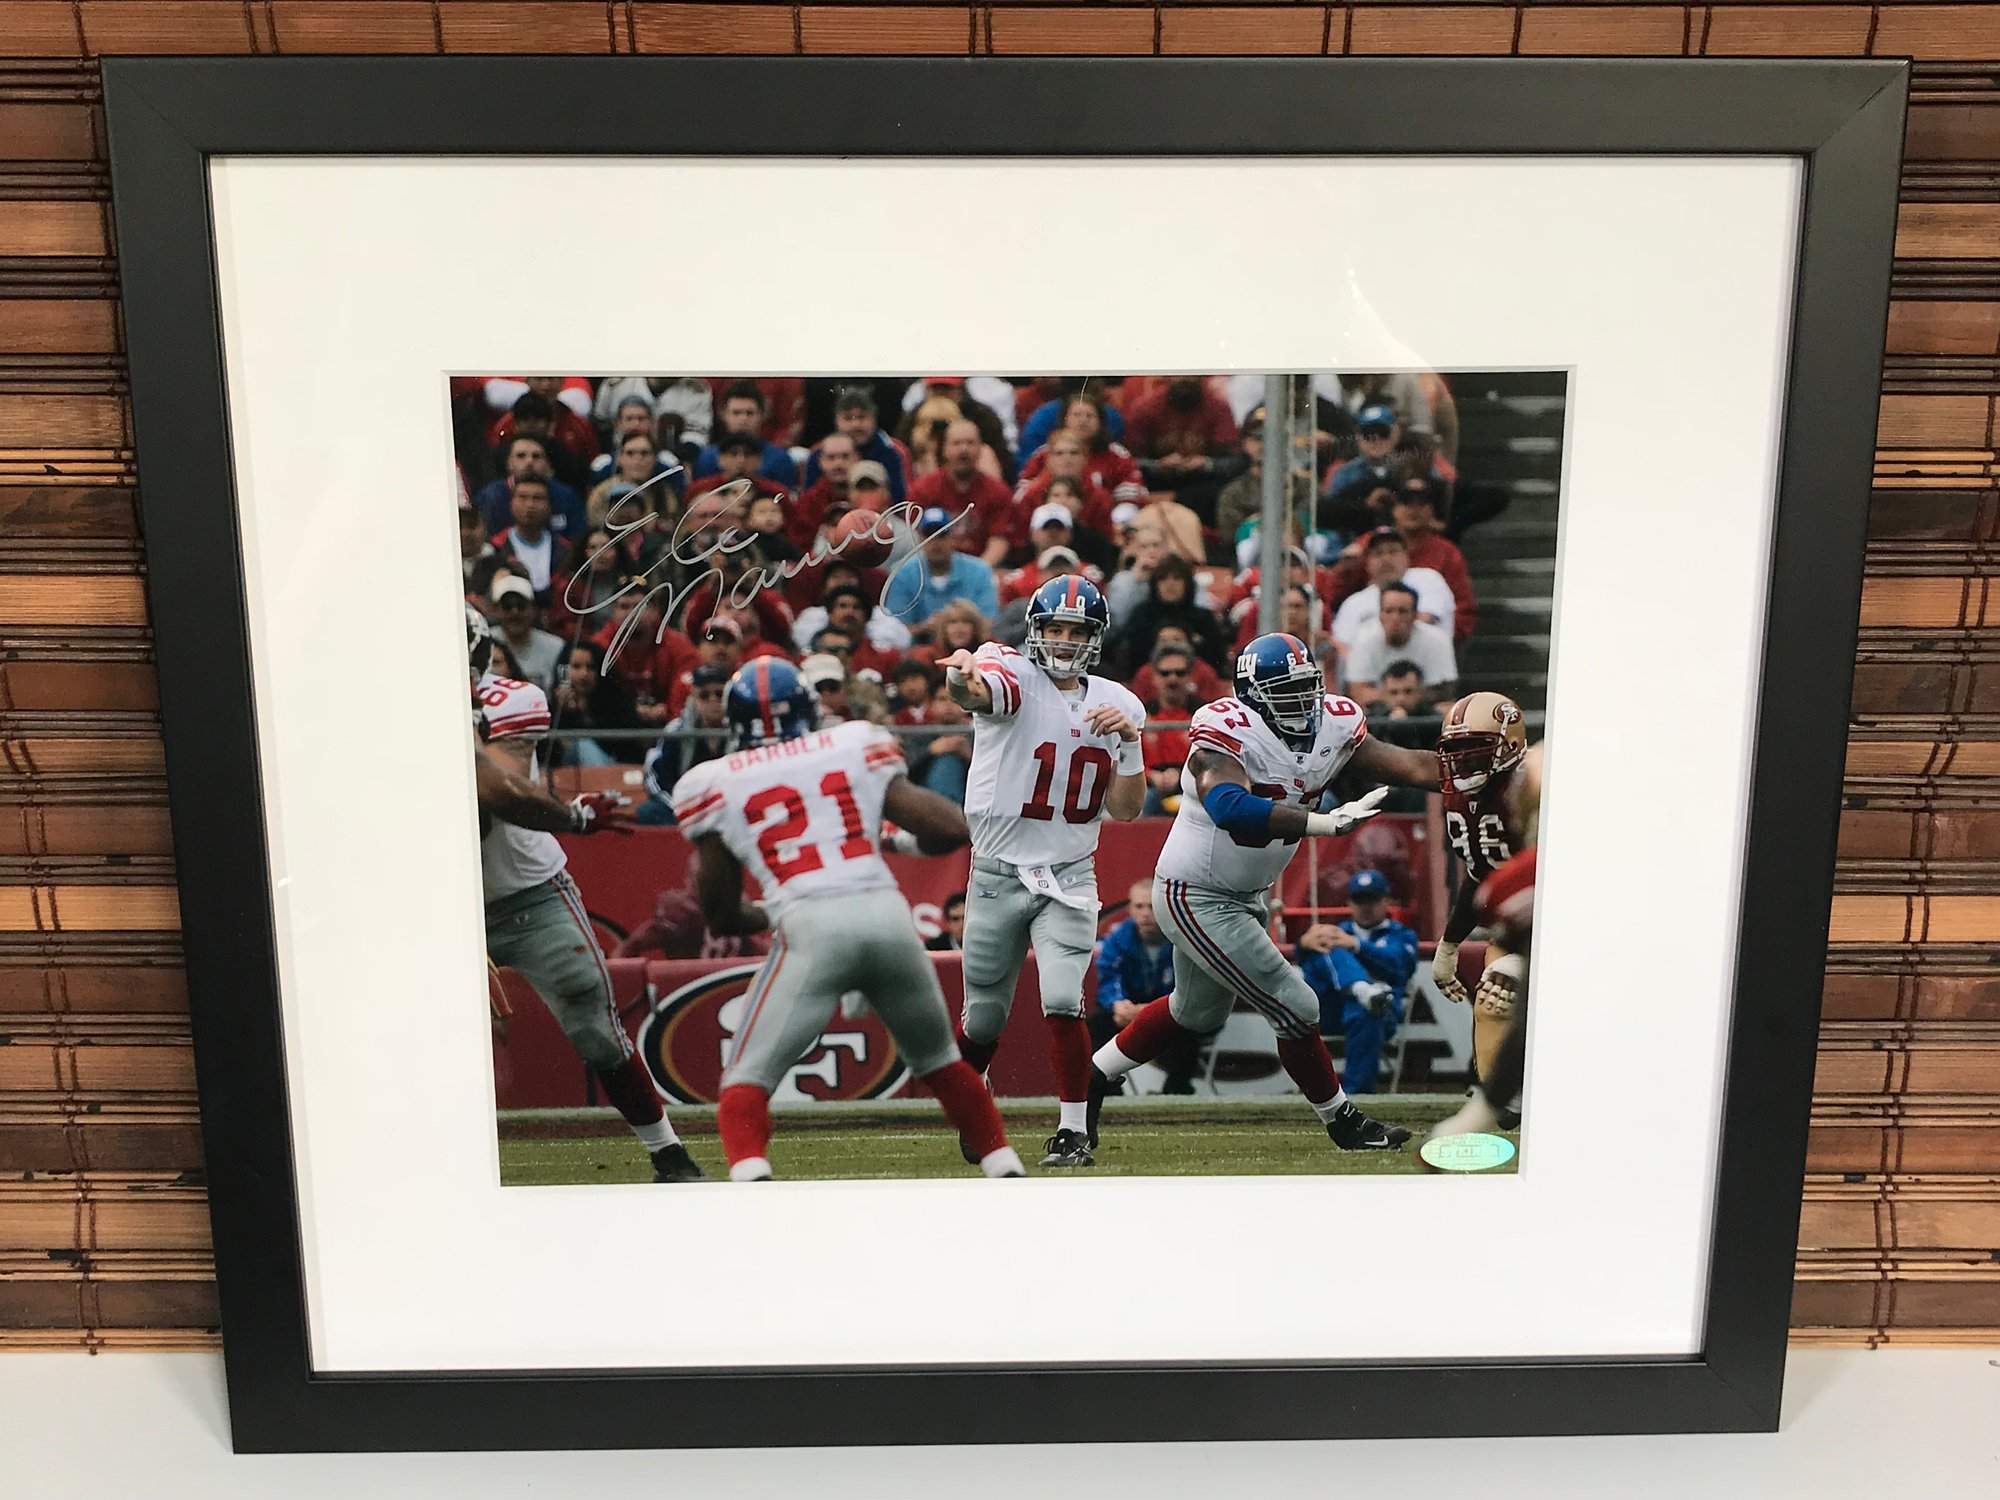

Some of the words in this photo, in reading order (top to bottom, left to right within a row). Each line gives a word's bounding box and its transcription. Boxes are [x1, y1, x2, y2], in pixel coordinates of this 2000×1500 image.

[1059, 593, 1086, 608] 10
[1020, 741, 1112, 824] 10
[743, 769, 875, 886] 21
